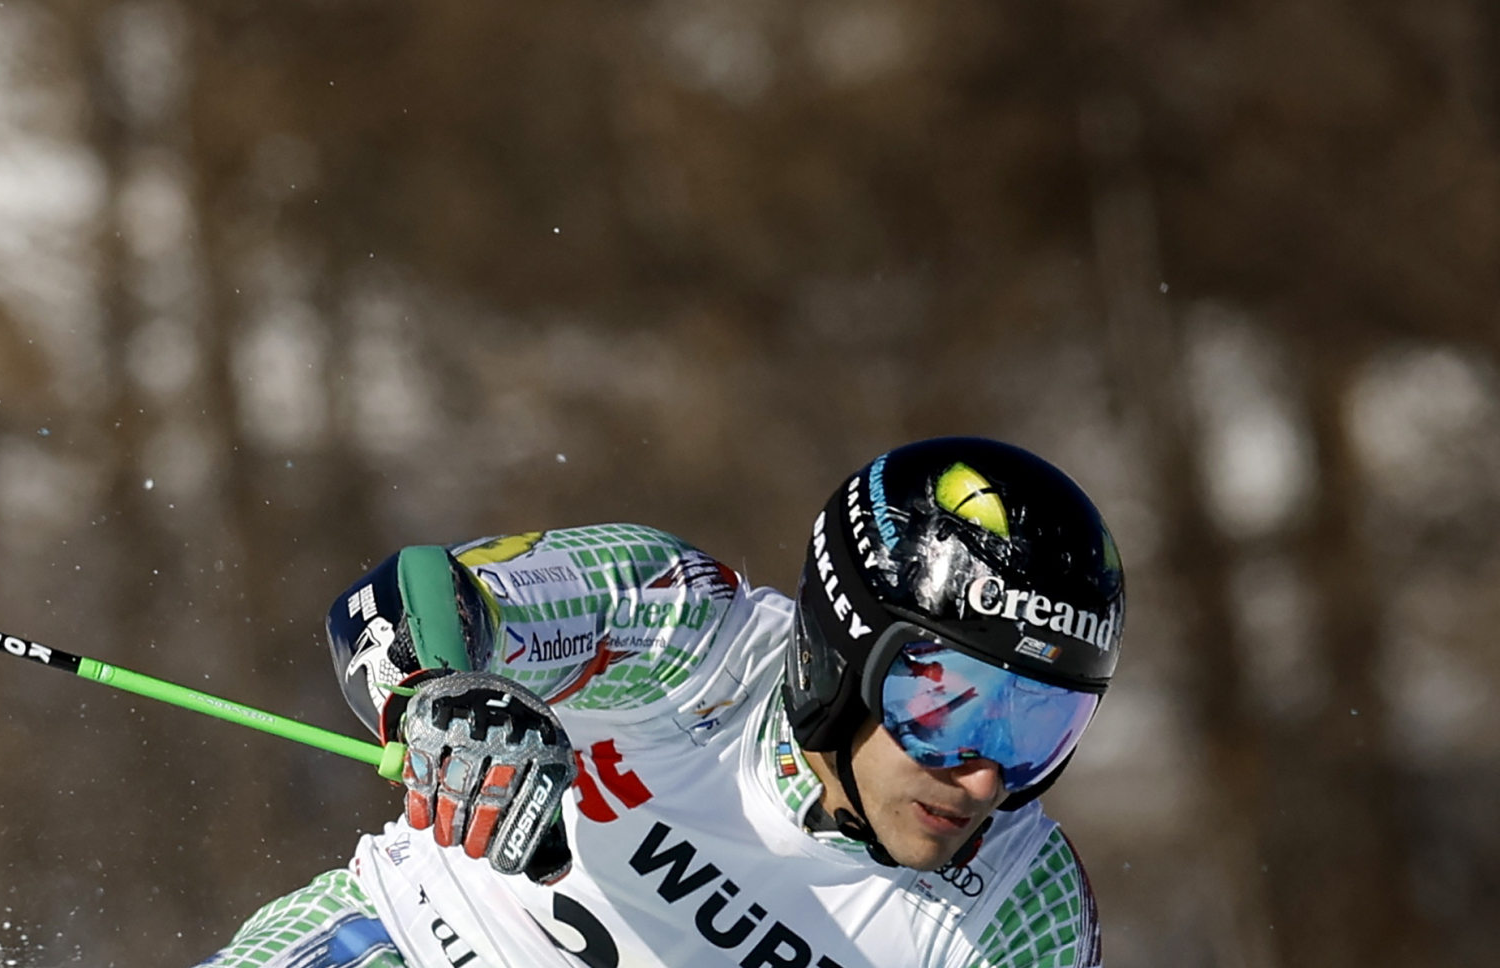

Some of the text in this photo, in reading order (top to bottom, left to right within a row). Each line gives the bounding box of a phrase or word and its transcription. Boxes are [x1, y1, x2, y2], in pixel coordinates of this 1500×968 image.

[847, 476, 879, 570] OAKLEY
[508, 565, 578, 587] ALTAVISTA
[812, 510, 873, 641] OAKLEY
[967, 575, 1116, 652] Creand
[527, 628, 595, 663] Andorra
[503, 771, 555, 860] reusch
